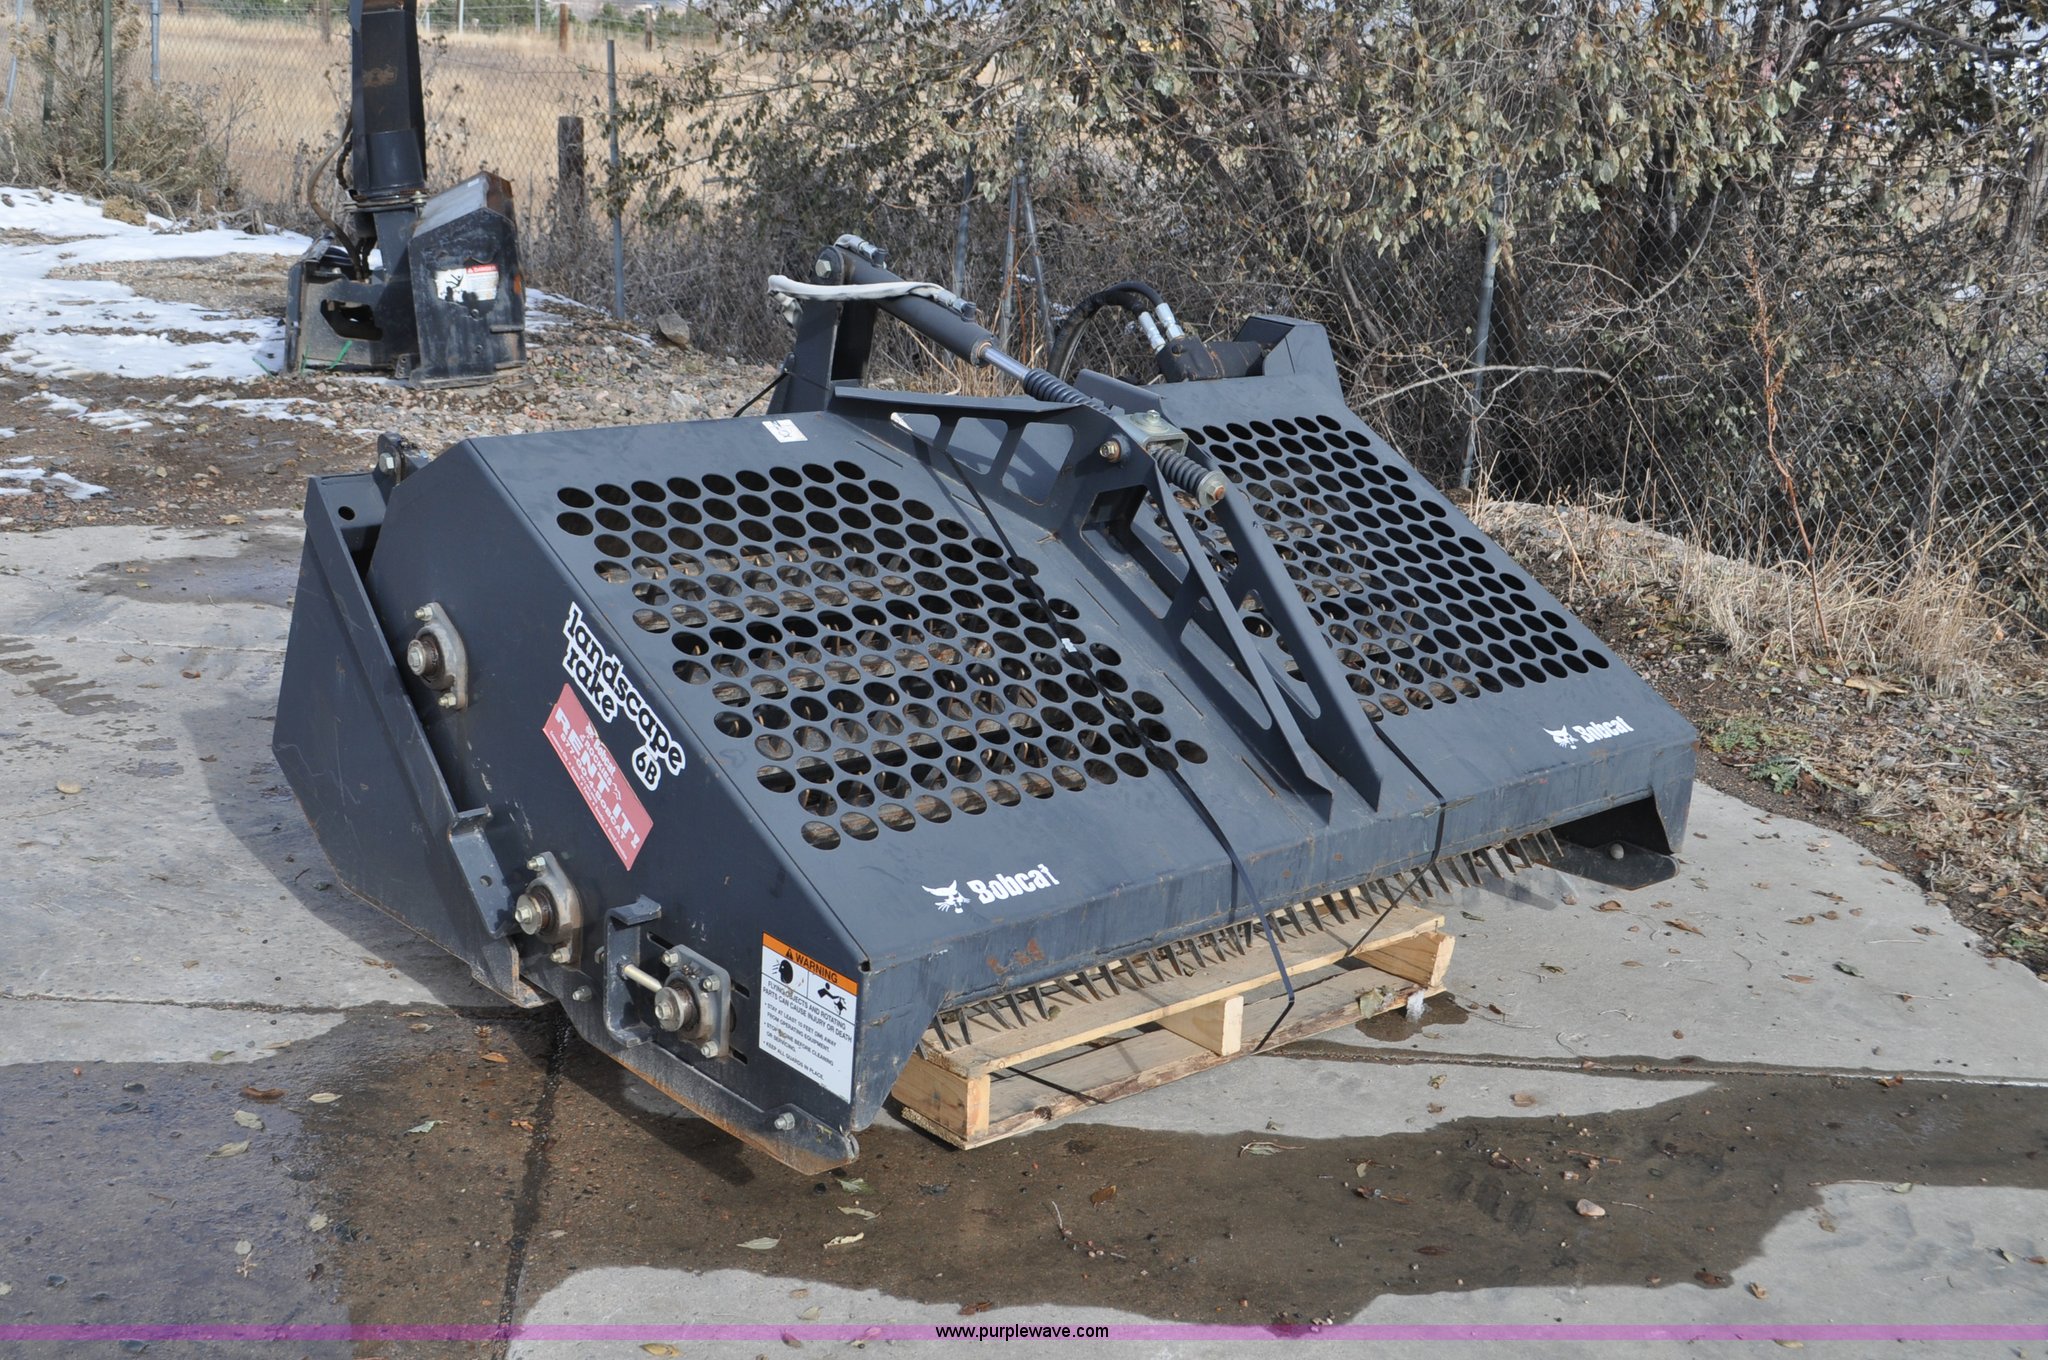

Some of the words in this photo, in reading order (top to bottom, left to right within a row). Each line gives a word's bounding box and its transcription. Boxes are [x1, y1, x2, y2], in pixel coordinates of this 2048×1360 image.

[566, 645, 616, 720] rake
[566, 606, 684, 773] landscape
[1571, 716, 1634, 743] Bobcat
[554, 706, 610, 800] RENT
[611, 801, 640, 850] IT!
[583, 738, 613, 787] ROCKIES
[592, 736, 617, 778] Bobcat
[634, 749, 659, 788] 6B
[966, 863, 1060, 905] Bobcat
[795, 952, 838, 984] WARNING
[763, 985, 777, 999] PARTS
[778, 994, 788, 1006] CAN
[790, 1001, 806, 1017] CAUSE
[807, 1011, 825, 1028] INJURY
[826, 1022, 834, 1033] OR
[835, 1027, 851, 1043] DEATH
[766, 1030, 772, 1038] OR
[767, 1010, 778, 1022] FROM
[779, 1018, 803, 1037] OPERATING
[767, 1002, 776, 1012] STAY
[777, 1008, 782, 1016] AT
[783, 1011, 796, 1024] LEAST
[803, 1023, 813, 1034] FEET
[824, 1035, 836, 1048] AWAY
[809, 1003, 819, 1015] AND
[820, 1009, 845, 1031] ROTATING
[766, 1021, 777, 1033] STOP
[794, 1038, 810, 1053] BEFORE
[811, 1049, 833, 1066] CLEANING
[766, 1040, 776, 1051] KEEP
[785, 1052, 803, 1068] GUARDS
[804, 1063, 808, 1071] IN
